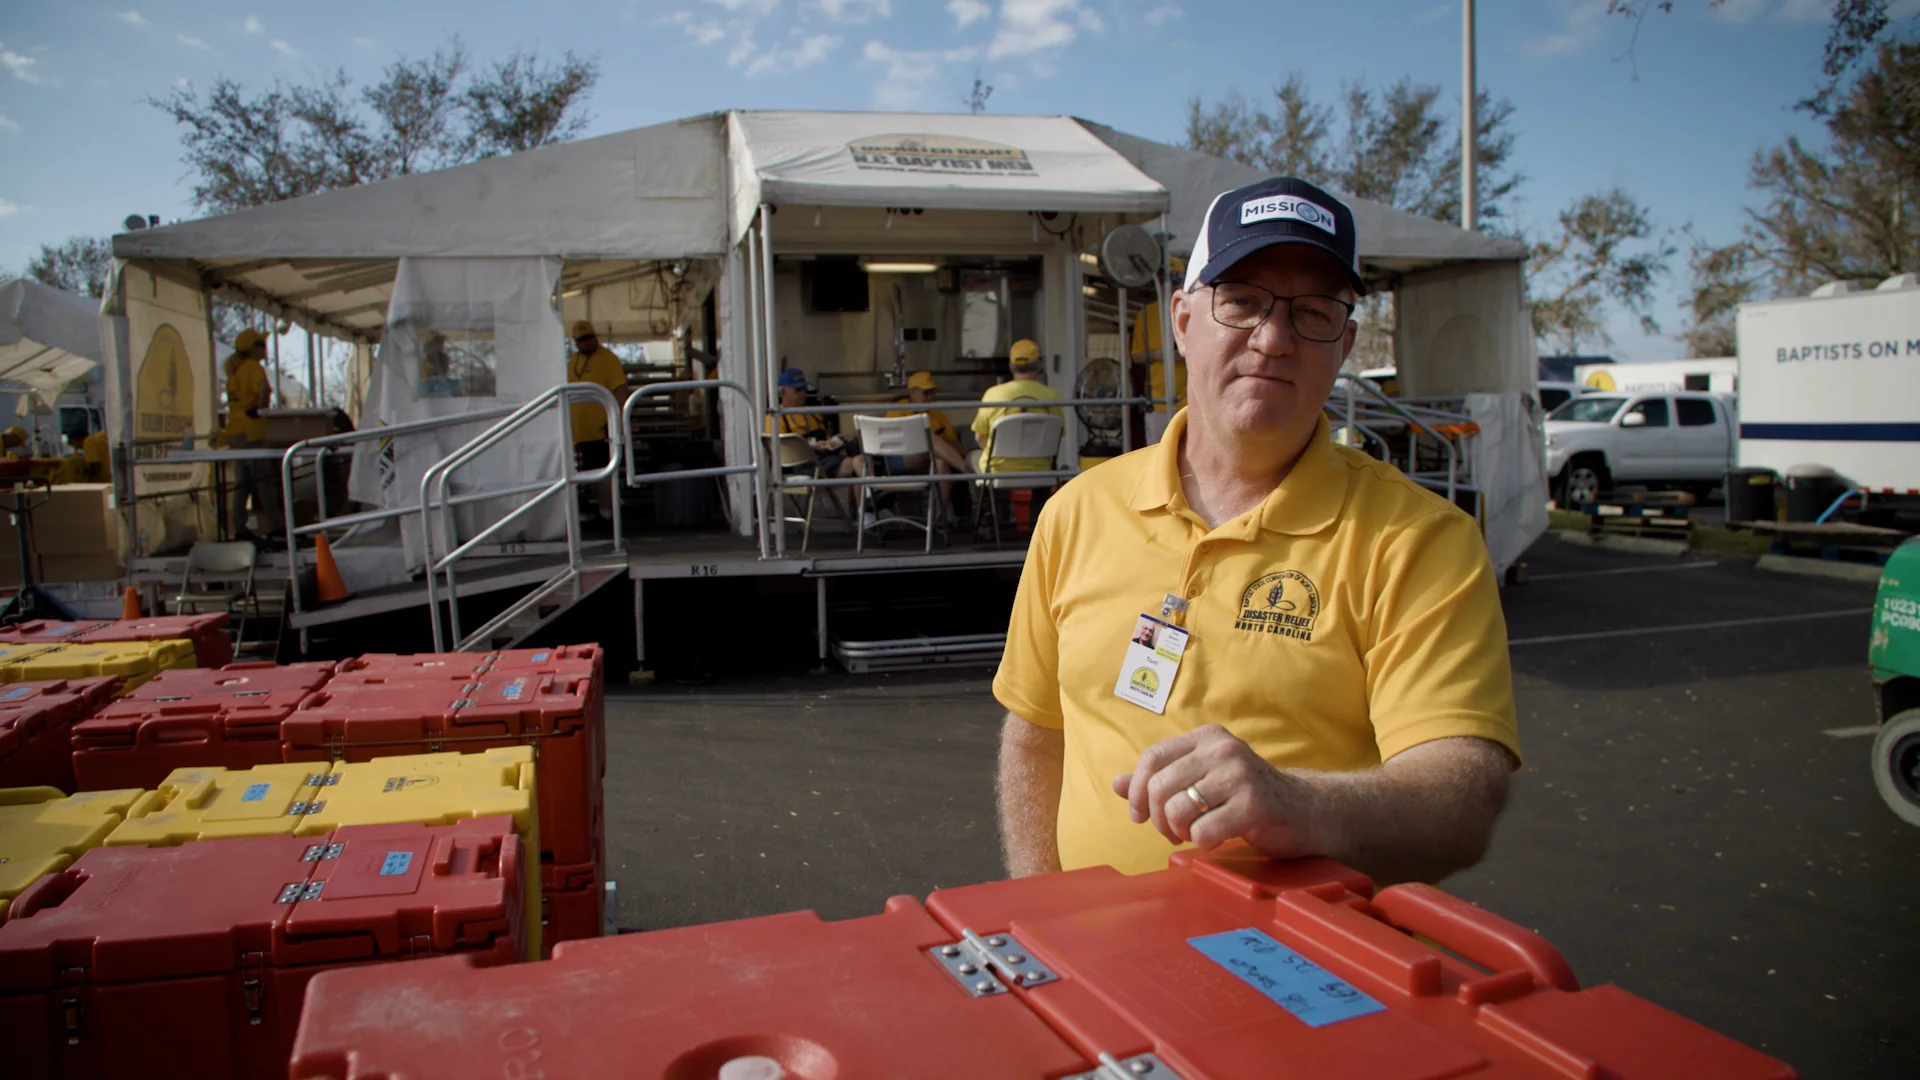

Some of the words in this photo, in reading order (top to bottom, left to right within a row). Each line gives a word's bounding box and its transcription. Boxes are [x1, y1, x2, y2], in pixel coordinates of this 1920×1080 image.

[895, 155, 984, 169] BAPTIST
[1245, 201, 1332, 227] MISSION
[1776, 342, 1863, 363] BAPTISTS
[1868, 341, 1899, 358] ON
[1243, 609, 1284, 624] DISASTER
[1284, 614, 1312, 628] RELIEF
[1234, 620, 1265, 633] NORTH
[1266, 624, 1312, 642] CAROLINA
[1146, 656, 1159, 666] Tom
